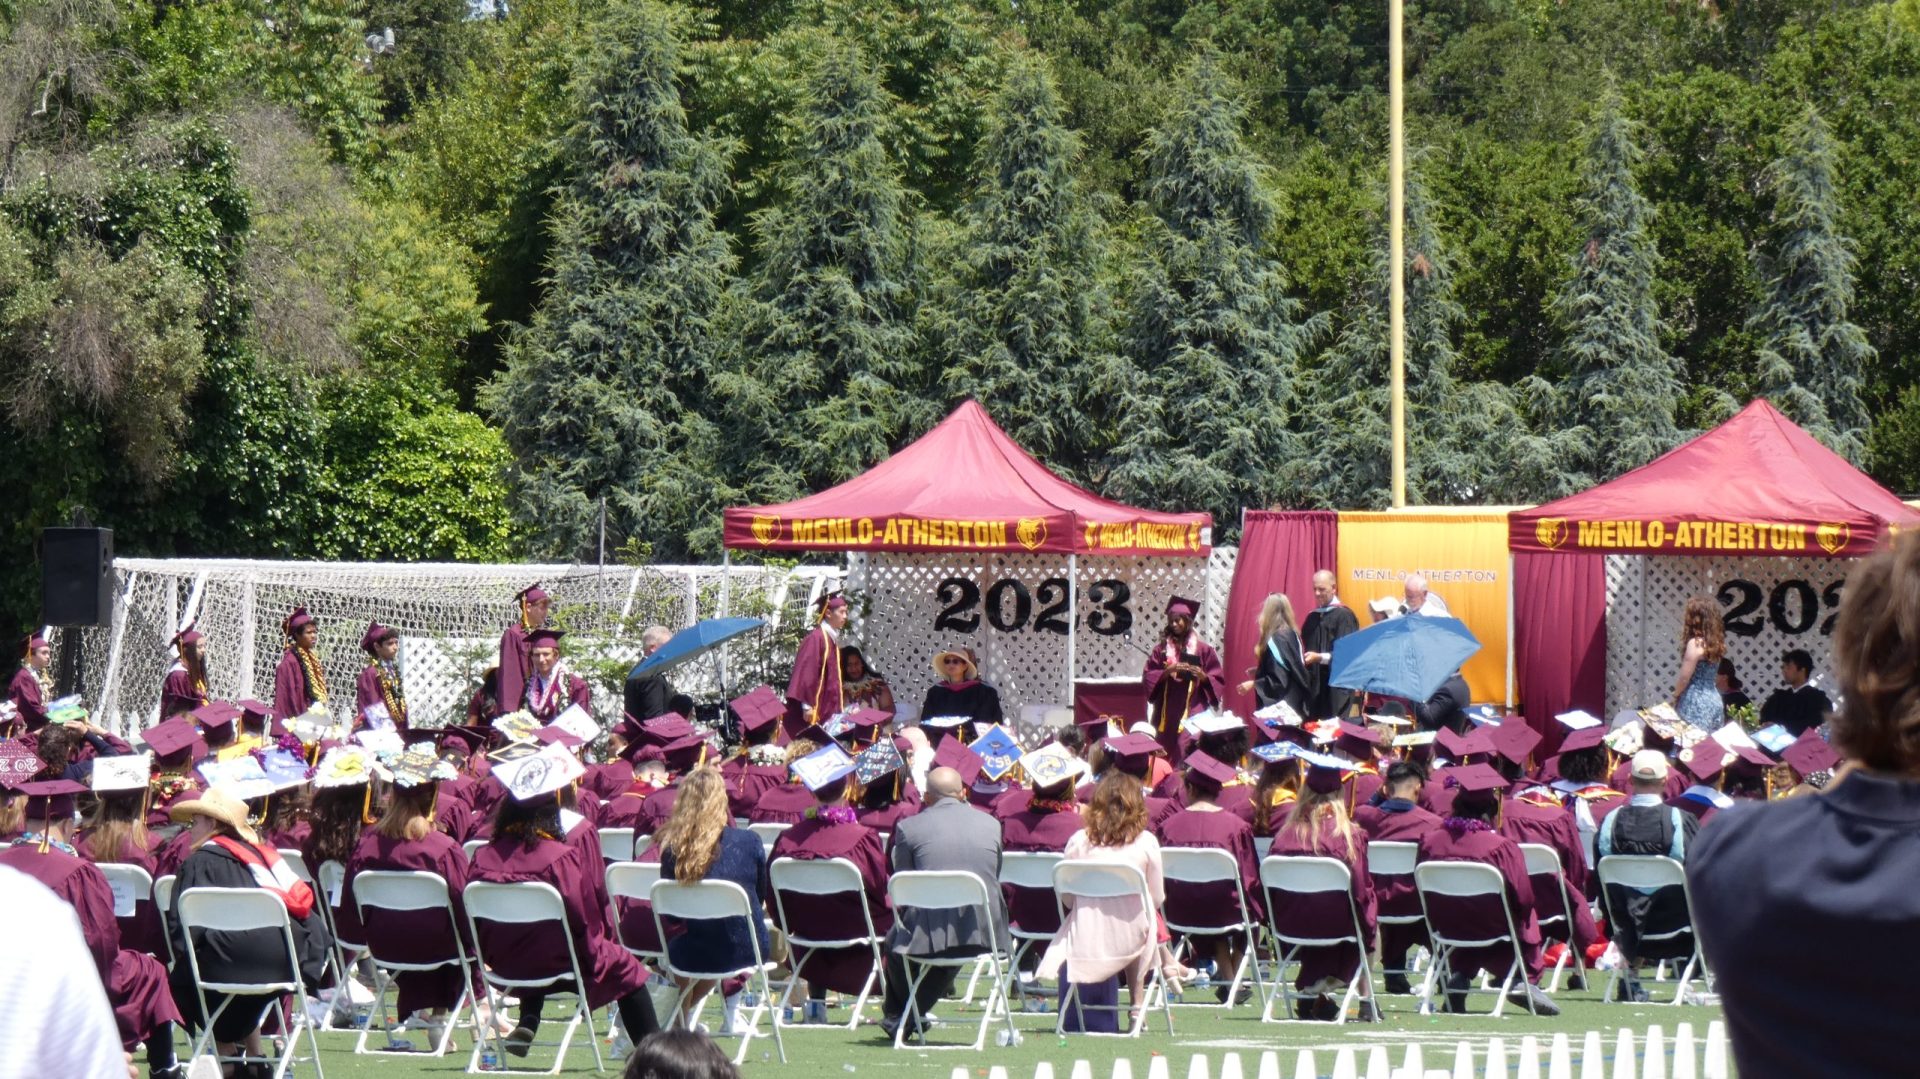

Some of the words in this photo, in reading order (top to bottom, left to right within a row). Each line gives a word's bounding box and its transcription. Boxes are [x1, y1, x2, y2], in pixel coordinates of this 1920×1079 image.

[791, 518, 1006, 547] MENLO-ATHERTON
[1100, 521, 1188, 550] MENLO-ATHERTON
[1577, 520, 1806, 550] MENLO-ATHERTON
[933, 577, 1133, 636] 2023
